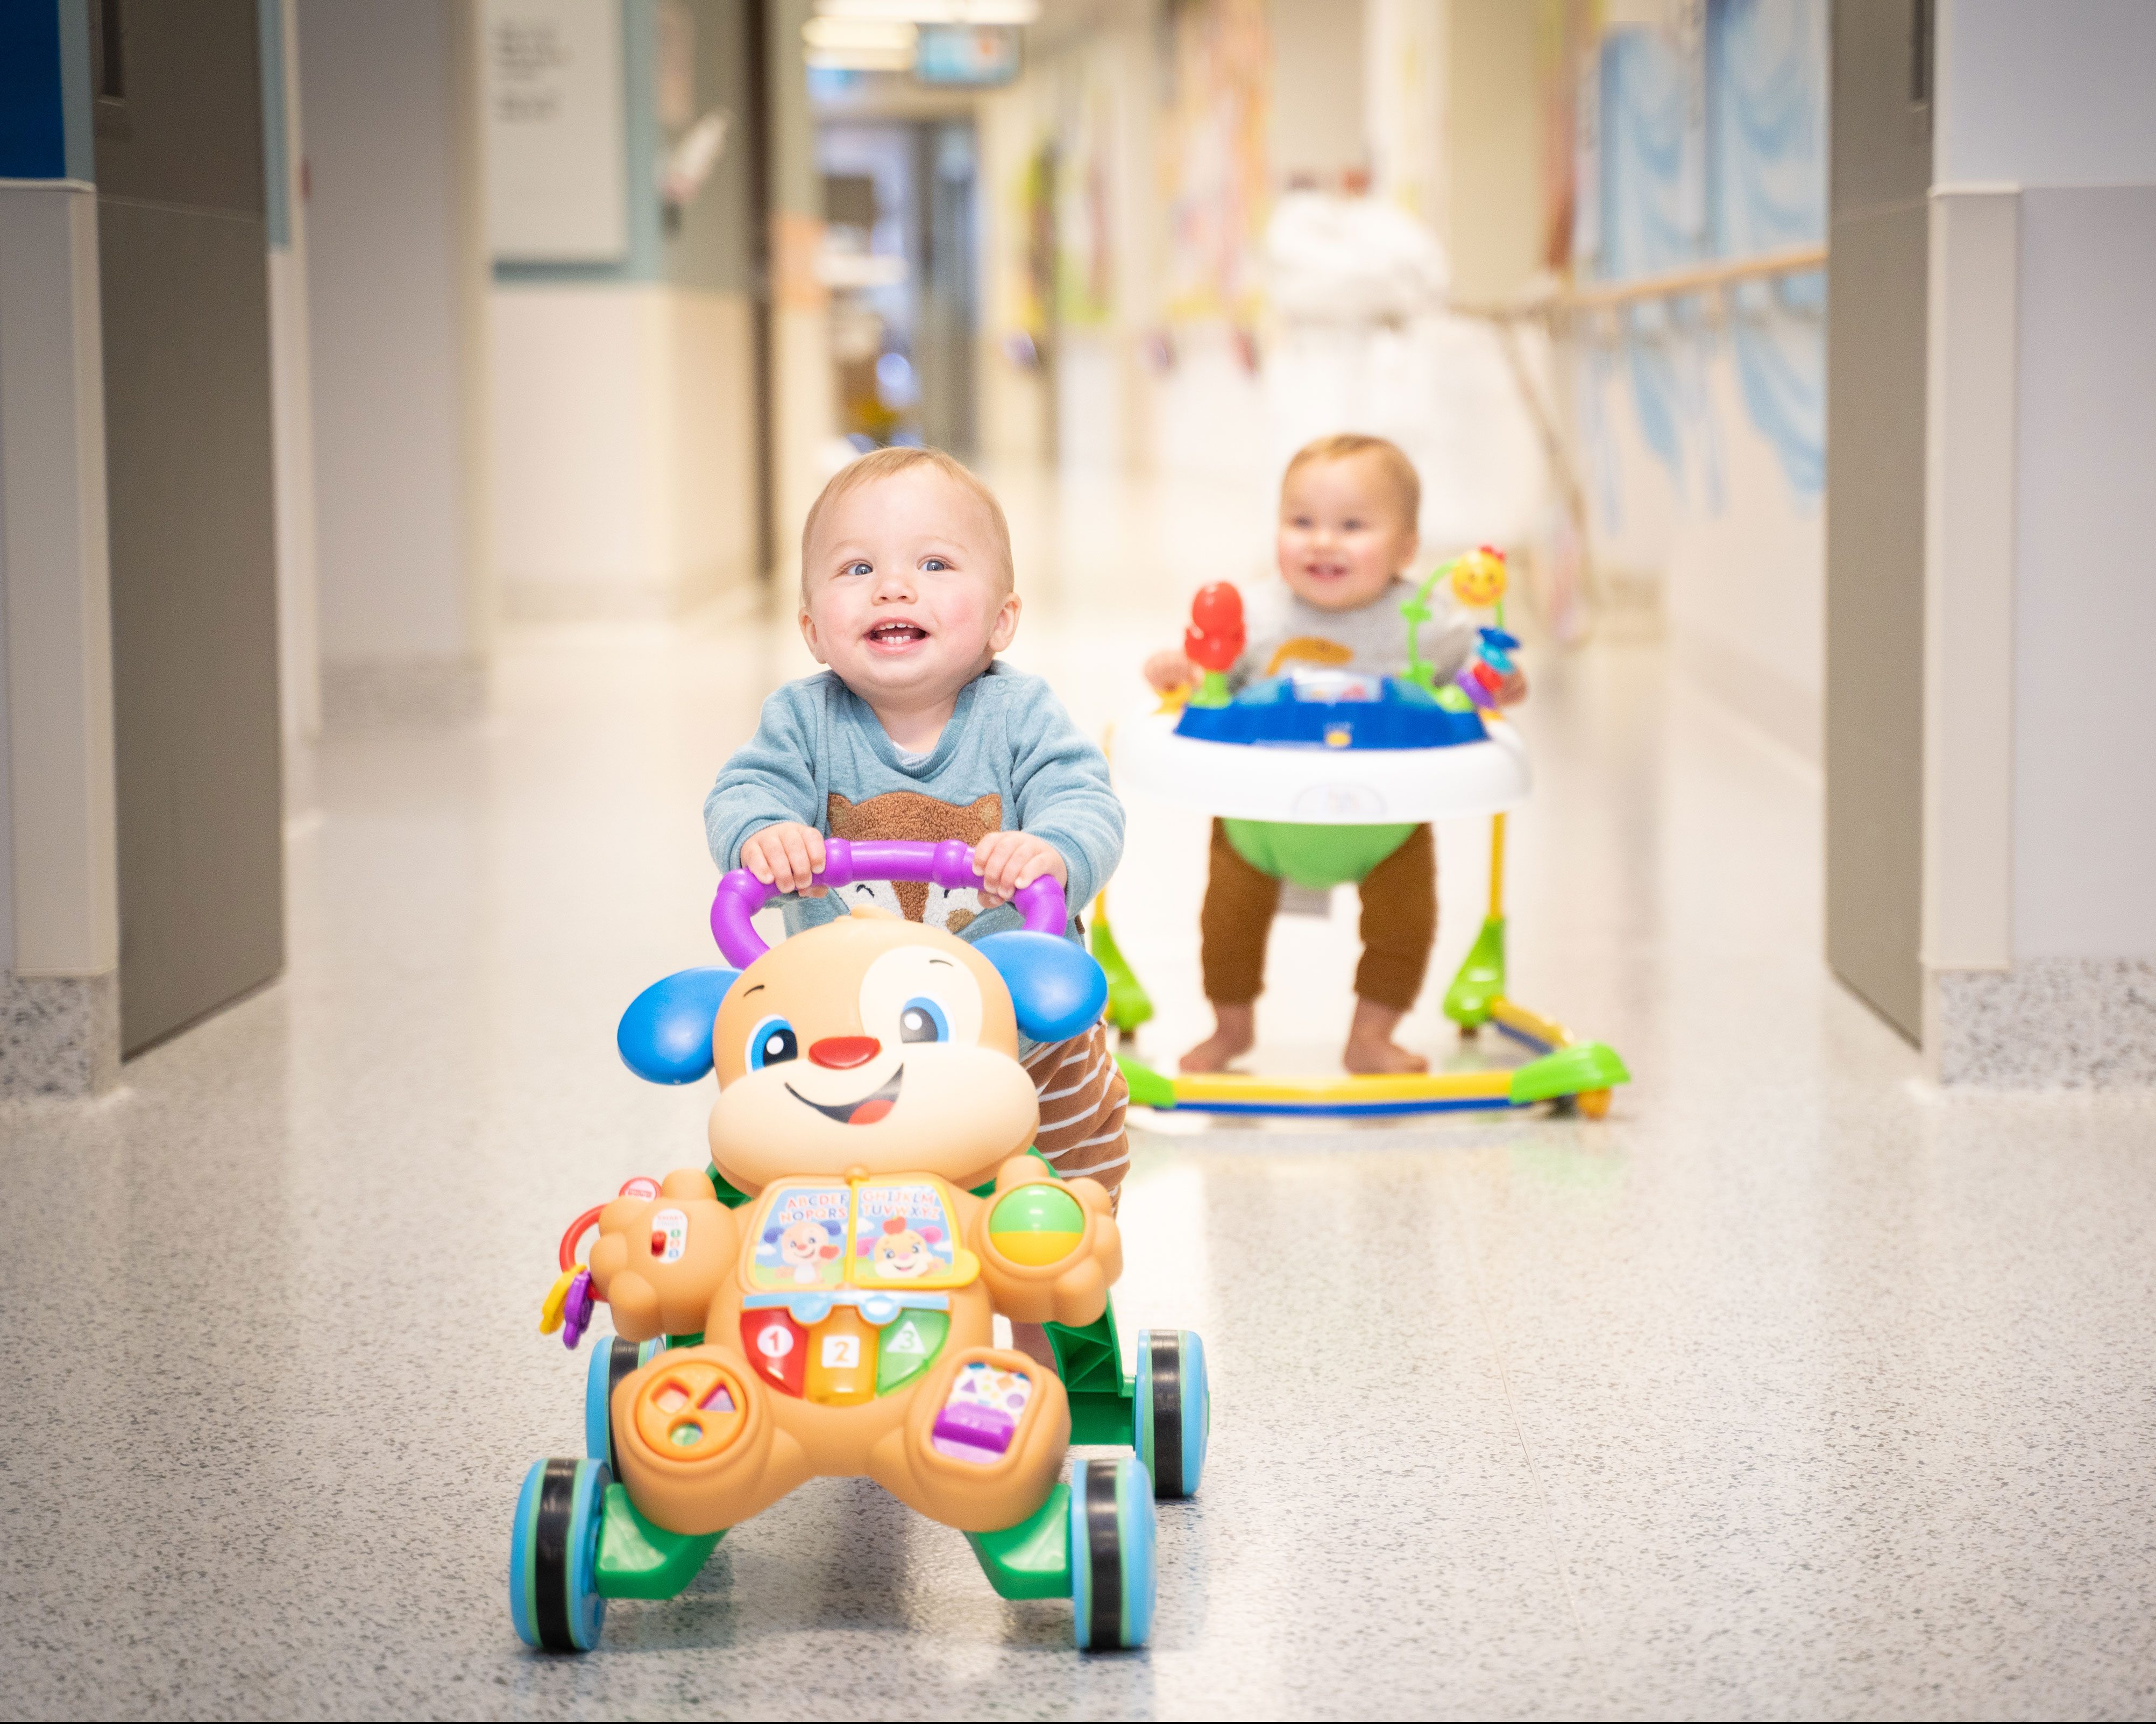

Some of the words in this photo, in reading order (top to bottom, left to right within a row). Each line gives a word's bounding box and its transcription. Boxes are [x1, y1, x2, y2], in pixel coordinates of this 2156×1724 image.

[768, 1330, 779, 1352] 1
[899, 1330, 914, 1350] 3
[834, 1341, 849, 1362] 2
